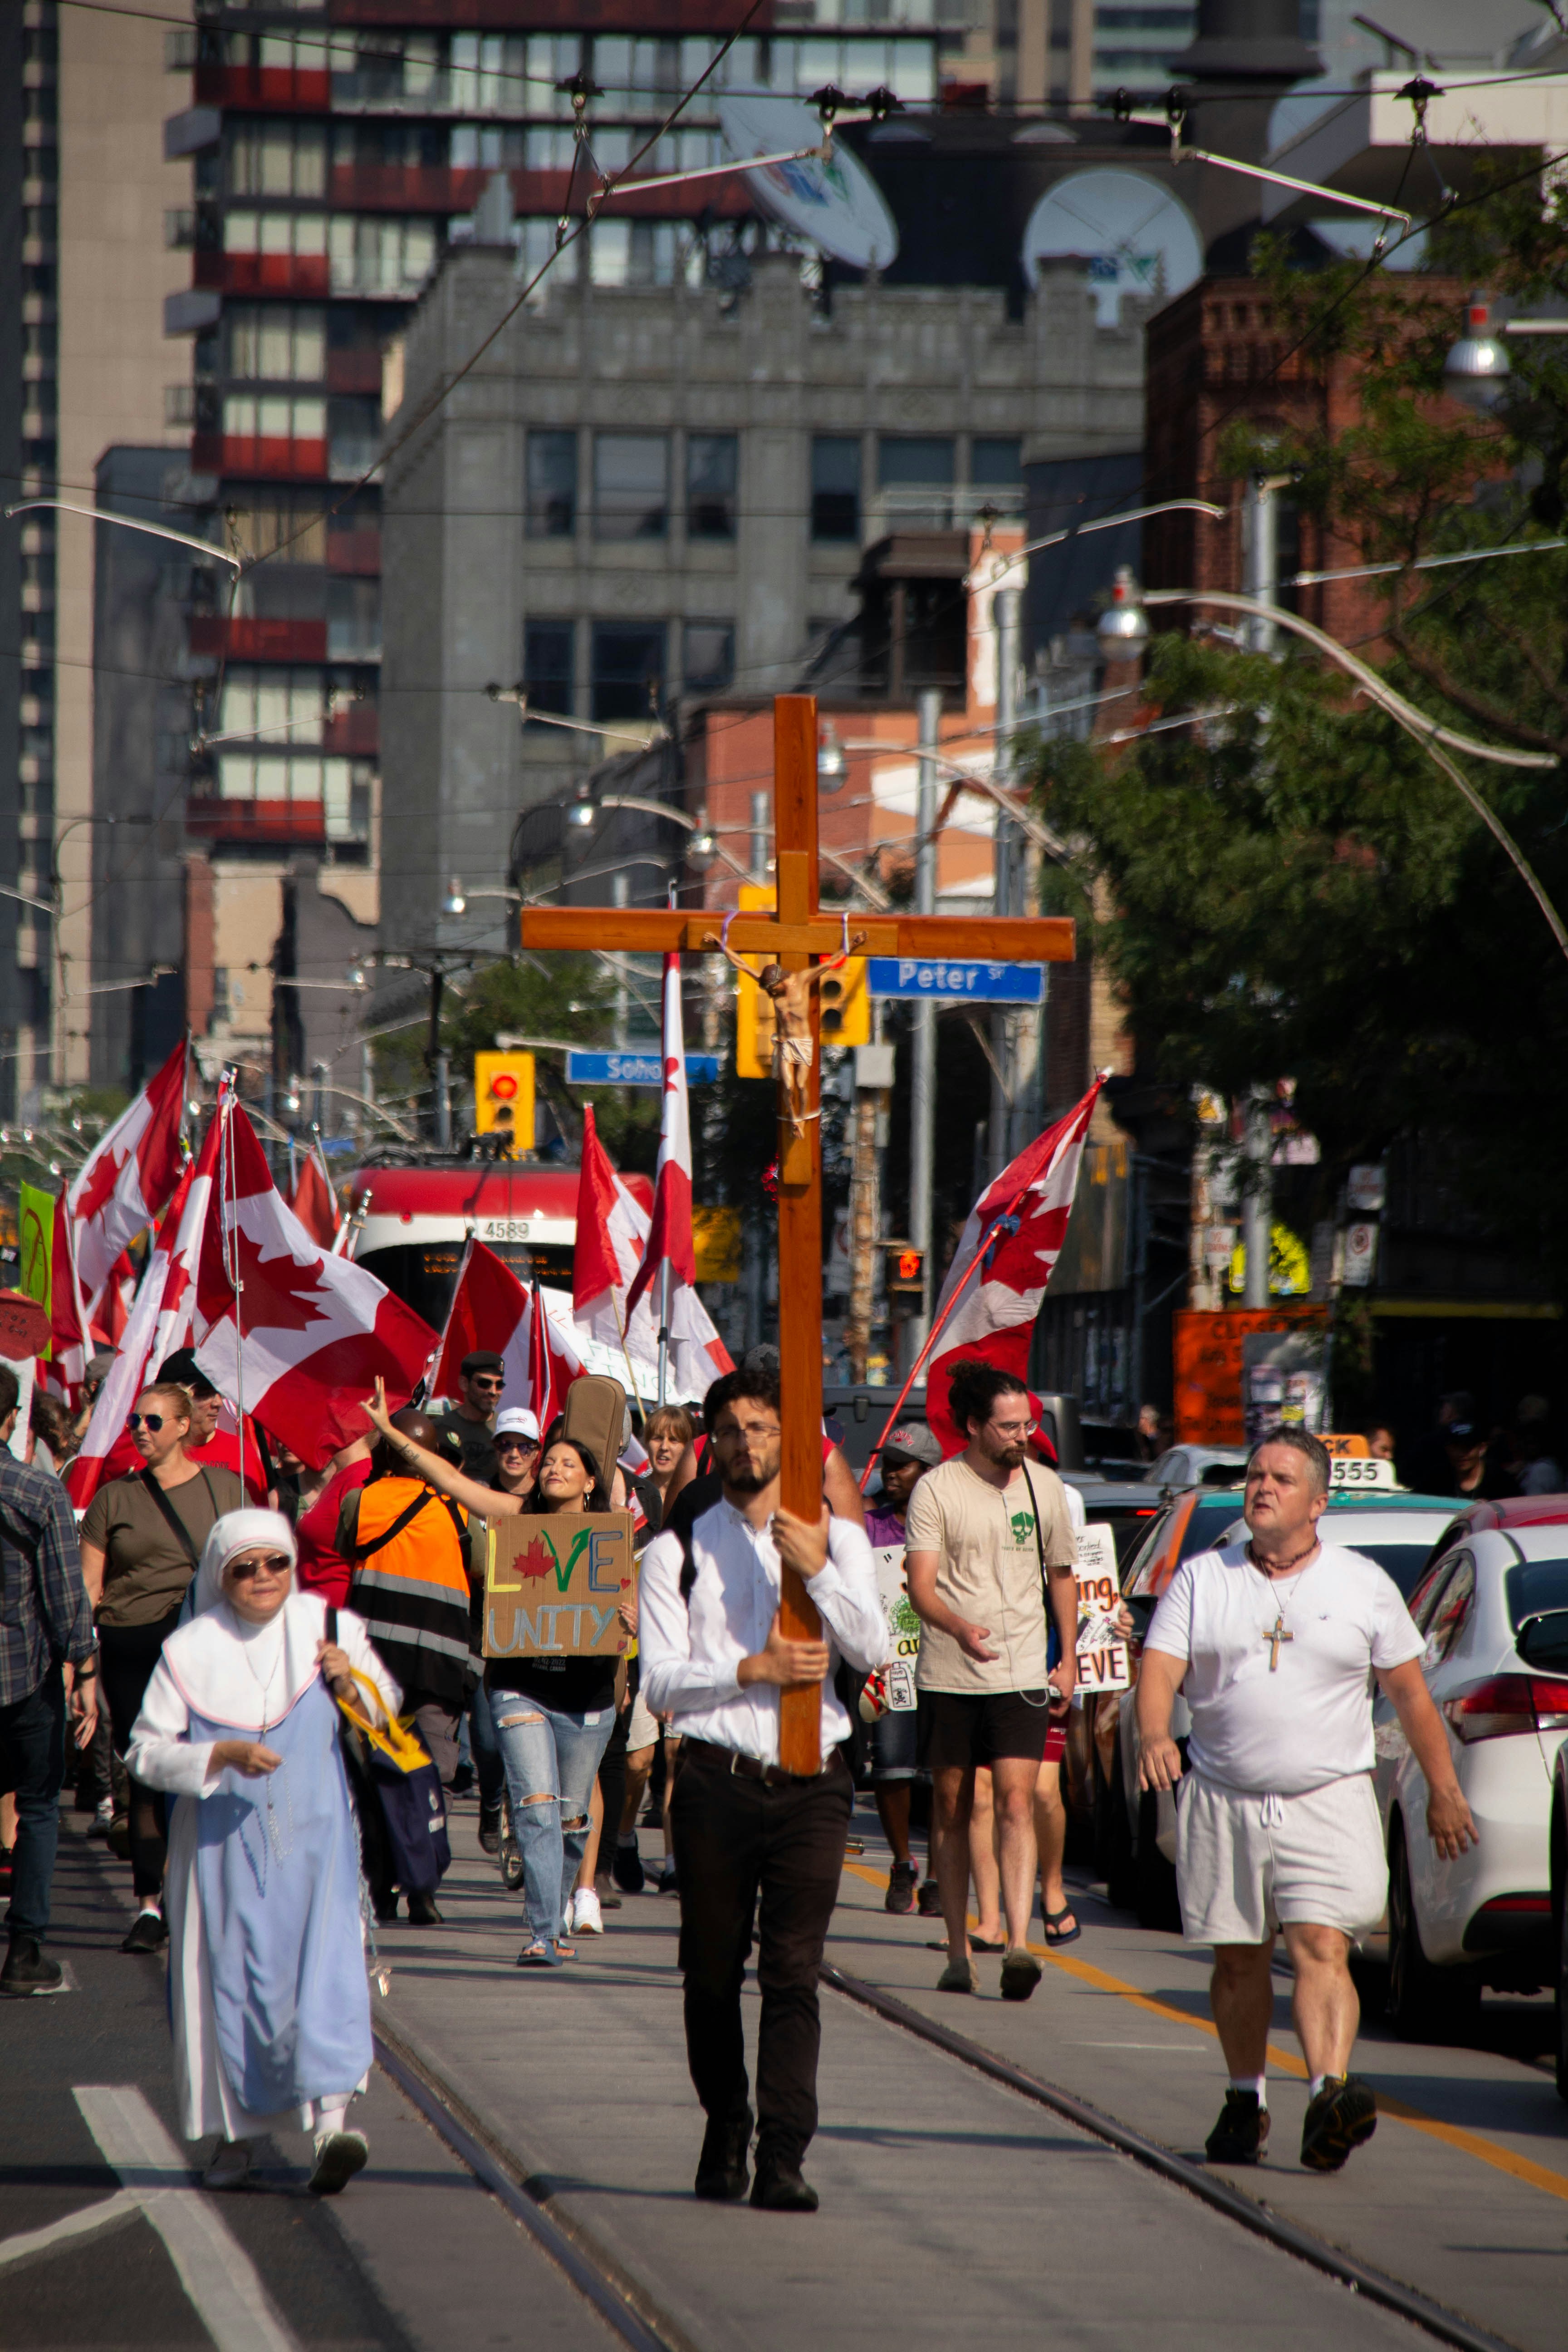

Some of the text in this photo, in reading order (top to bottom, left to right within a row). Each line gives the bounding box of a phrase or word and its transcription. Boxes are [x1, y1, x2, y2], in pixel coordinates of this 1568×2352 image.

[899, 961, 979, 990] Peter
[606, 1055, 662, 1079] Soho
[485, 1222, 529, 1239] 4589
[488, 1603, 616, 1654] UNITY
